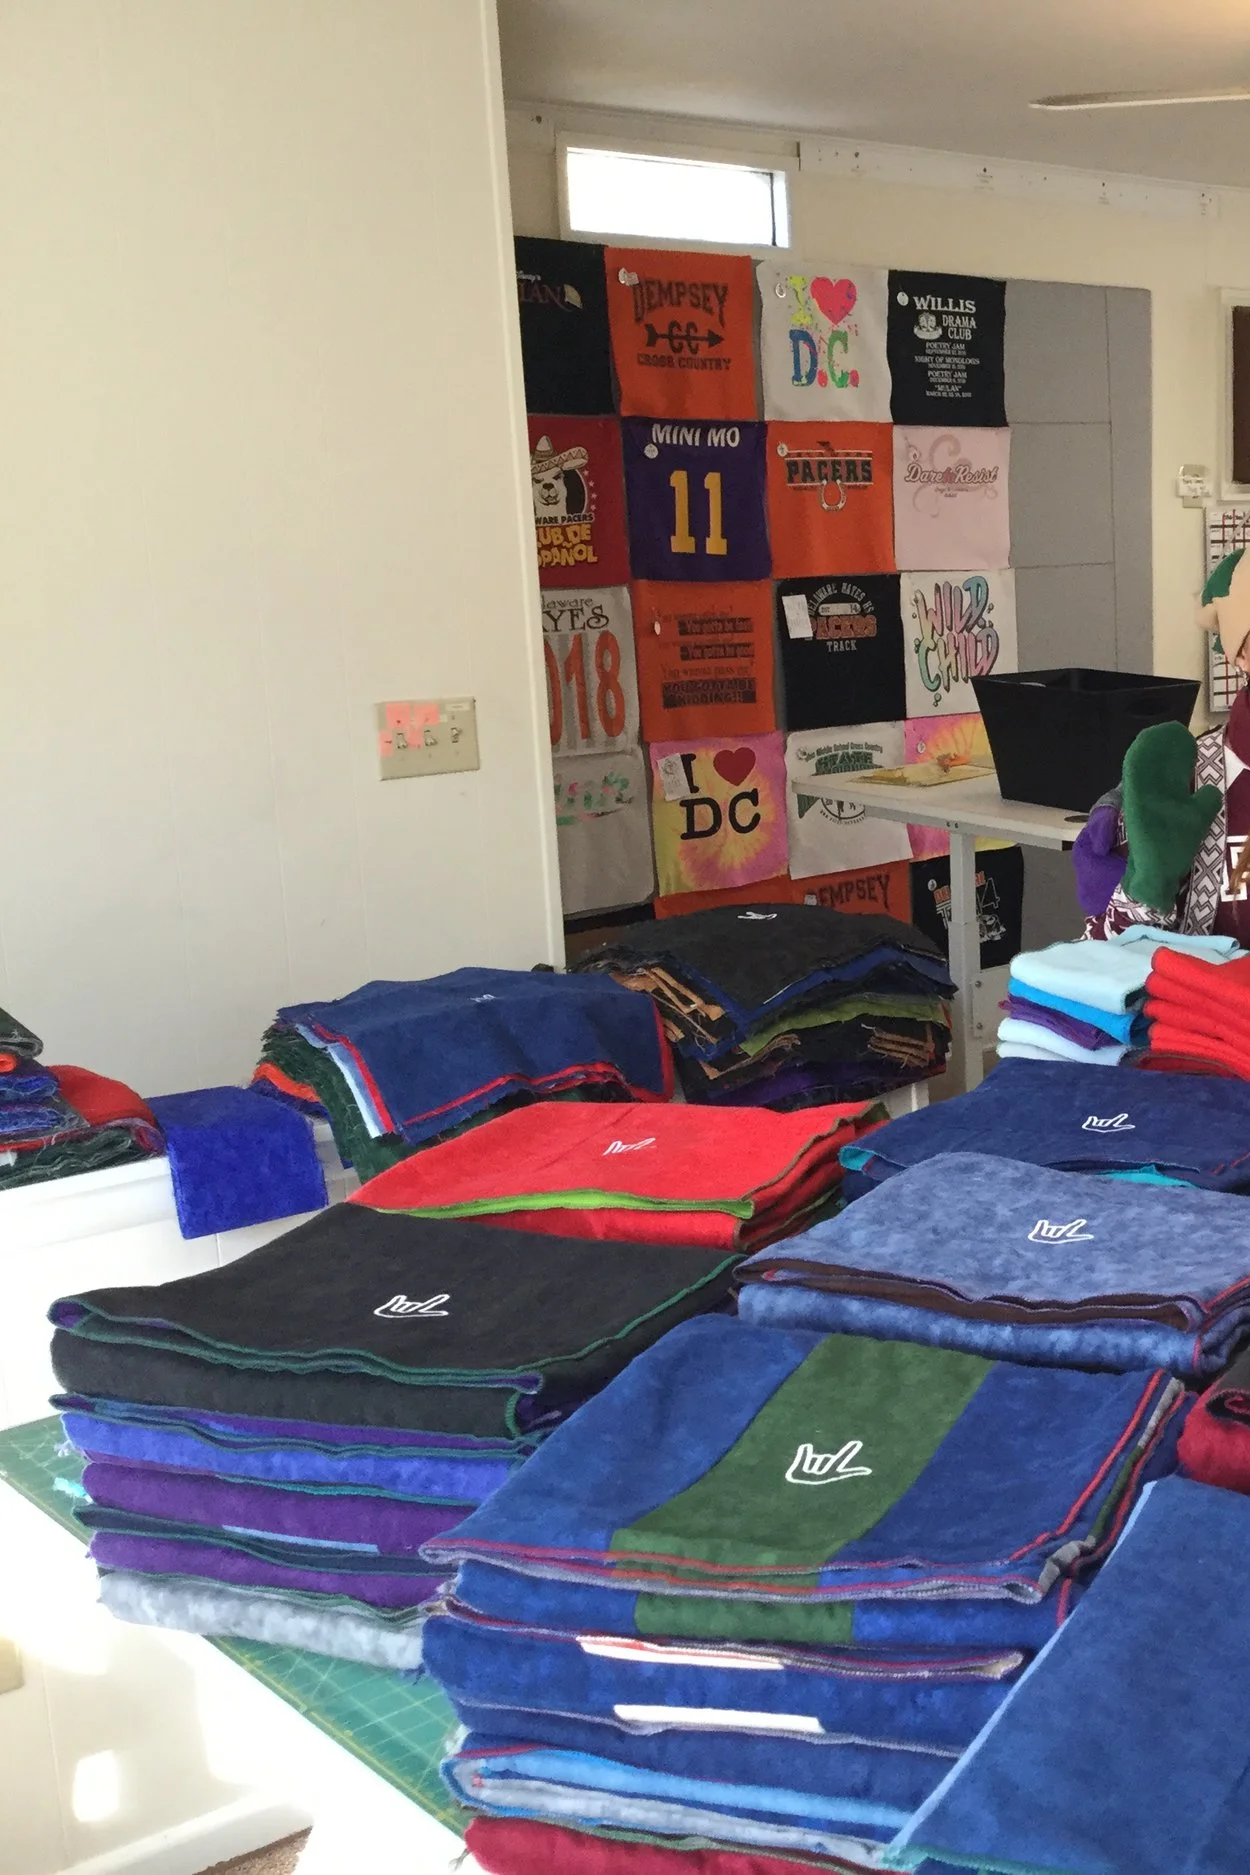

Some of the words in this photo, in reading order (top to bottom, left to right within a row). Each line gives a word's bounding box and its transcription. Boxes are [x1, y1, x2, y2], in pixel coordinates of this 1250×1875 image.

[633, 278, 729, 328] DEMPSEY
[787, 275, 813, 325] I
[912, 295, 976, 314] WILLIS
[942, 314, 977, 330] DRAMA
[947, 328, 972, 341] CLUB
[668, 320, 699, 354] CC
[637, 353, 674, 368] CROSS
[678, 357, 731, 370] COUNTRY
[789, 329, 860, 388] D.C.
[927, 370, 952, 378] POETRY
[953, 371, 968, 379] JAM
[652, 423, 701, 448] MINI
[707, 426, 740, 448] MO
[786, 459, 873, 484] PACERS
[904, 462, 944, 484] Dare
[953, 464, 999, 485] Resist
[560, 512, 594, 524] PACERS
[669, 470, 728, 556] 11
[537, 526, 564, 547] UB
[565, 523, 592, 545] DE
[808, 583, 838, 616] DELAWARE
[841, 582, 866, 602] HAYES
[862, 600, 875, 613] HS
[911, 576, 989, 635] WILD
[826, 639, 857, 653] TRACK
[917, 626, 999, 693] CHILD
[679, 788, 761, 840] DC
